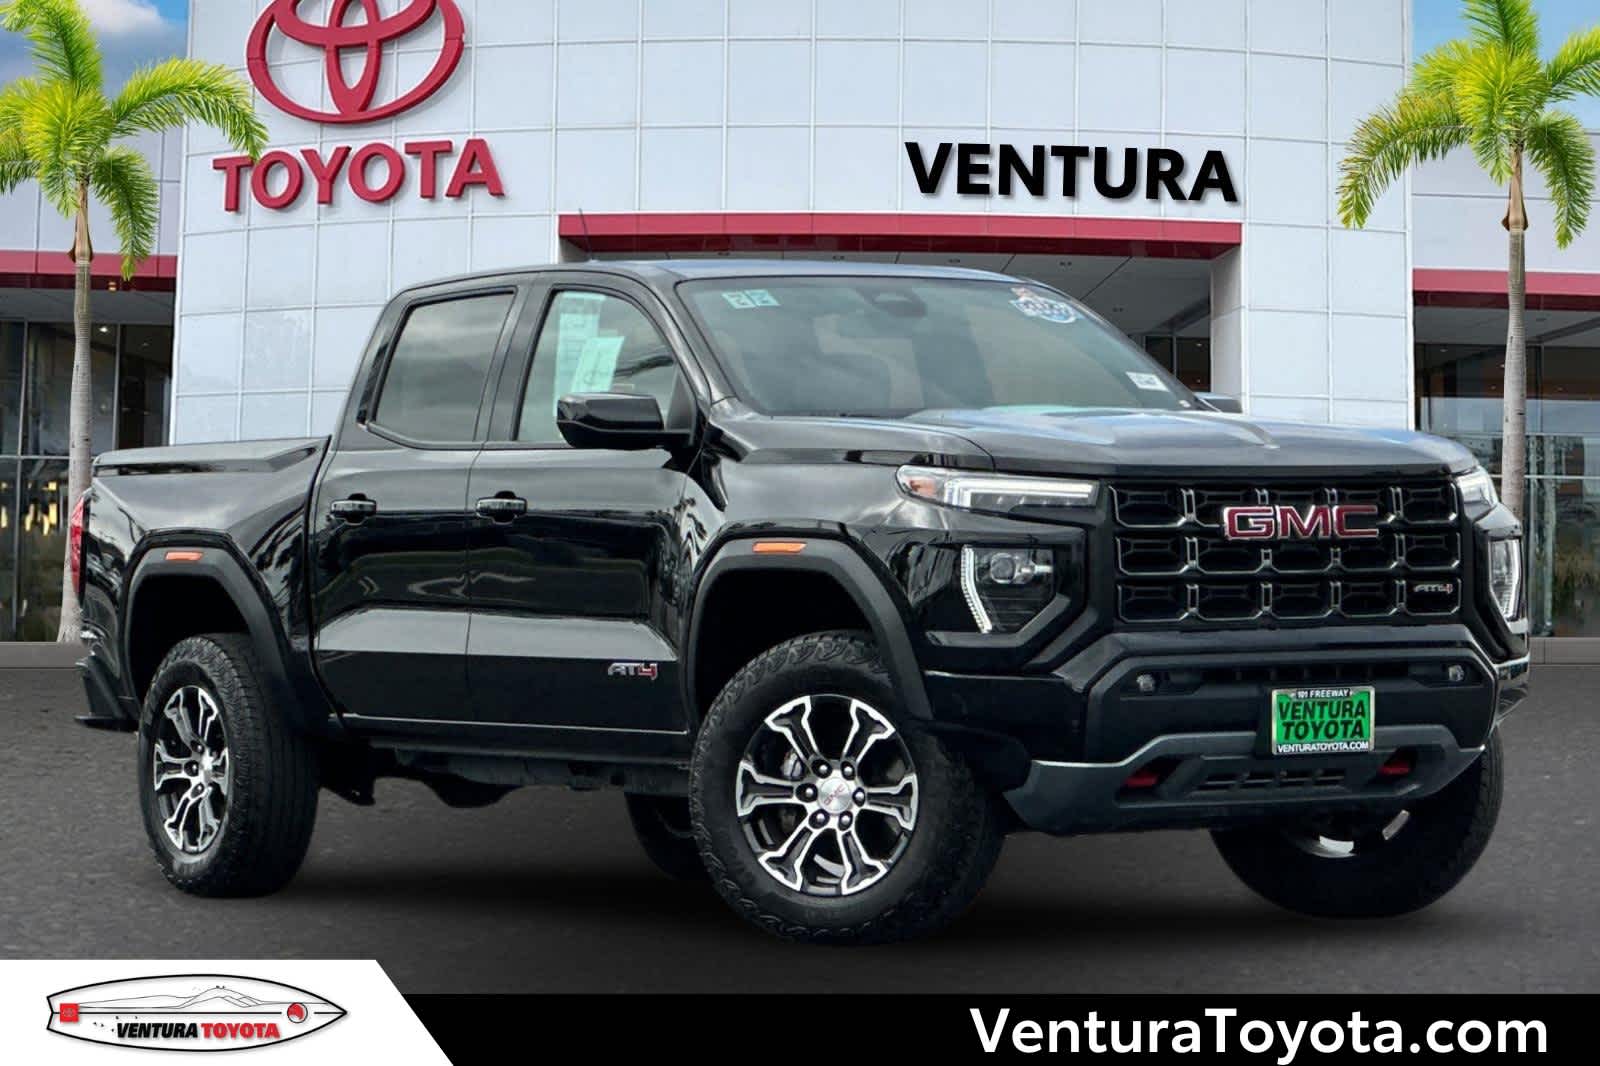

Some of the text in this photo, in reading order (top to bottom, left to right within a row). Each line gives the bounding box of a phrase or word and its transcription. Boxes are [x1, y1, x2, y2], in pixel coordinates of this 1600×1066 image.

[213, 138, 505, 213] TOYOTA
[904, 141, 1239, 203] VENTURA
[1223, 505, 1379, 540] GMC
[607, 662, 658, 680] AT4
[1309, 689, 1349, 698] FREEWAY
[1278, 700, 1366, 720] VENTURA
[1282, 720, 1365, 740] TOYOTA
[1277, 741, 1369, 753] VENTURATOYOTA.COM
